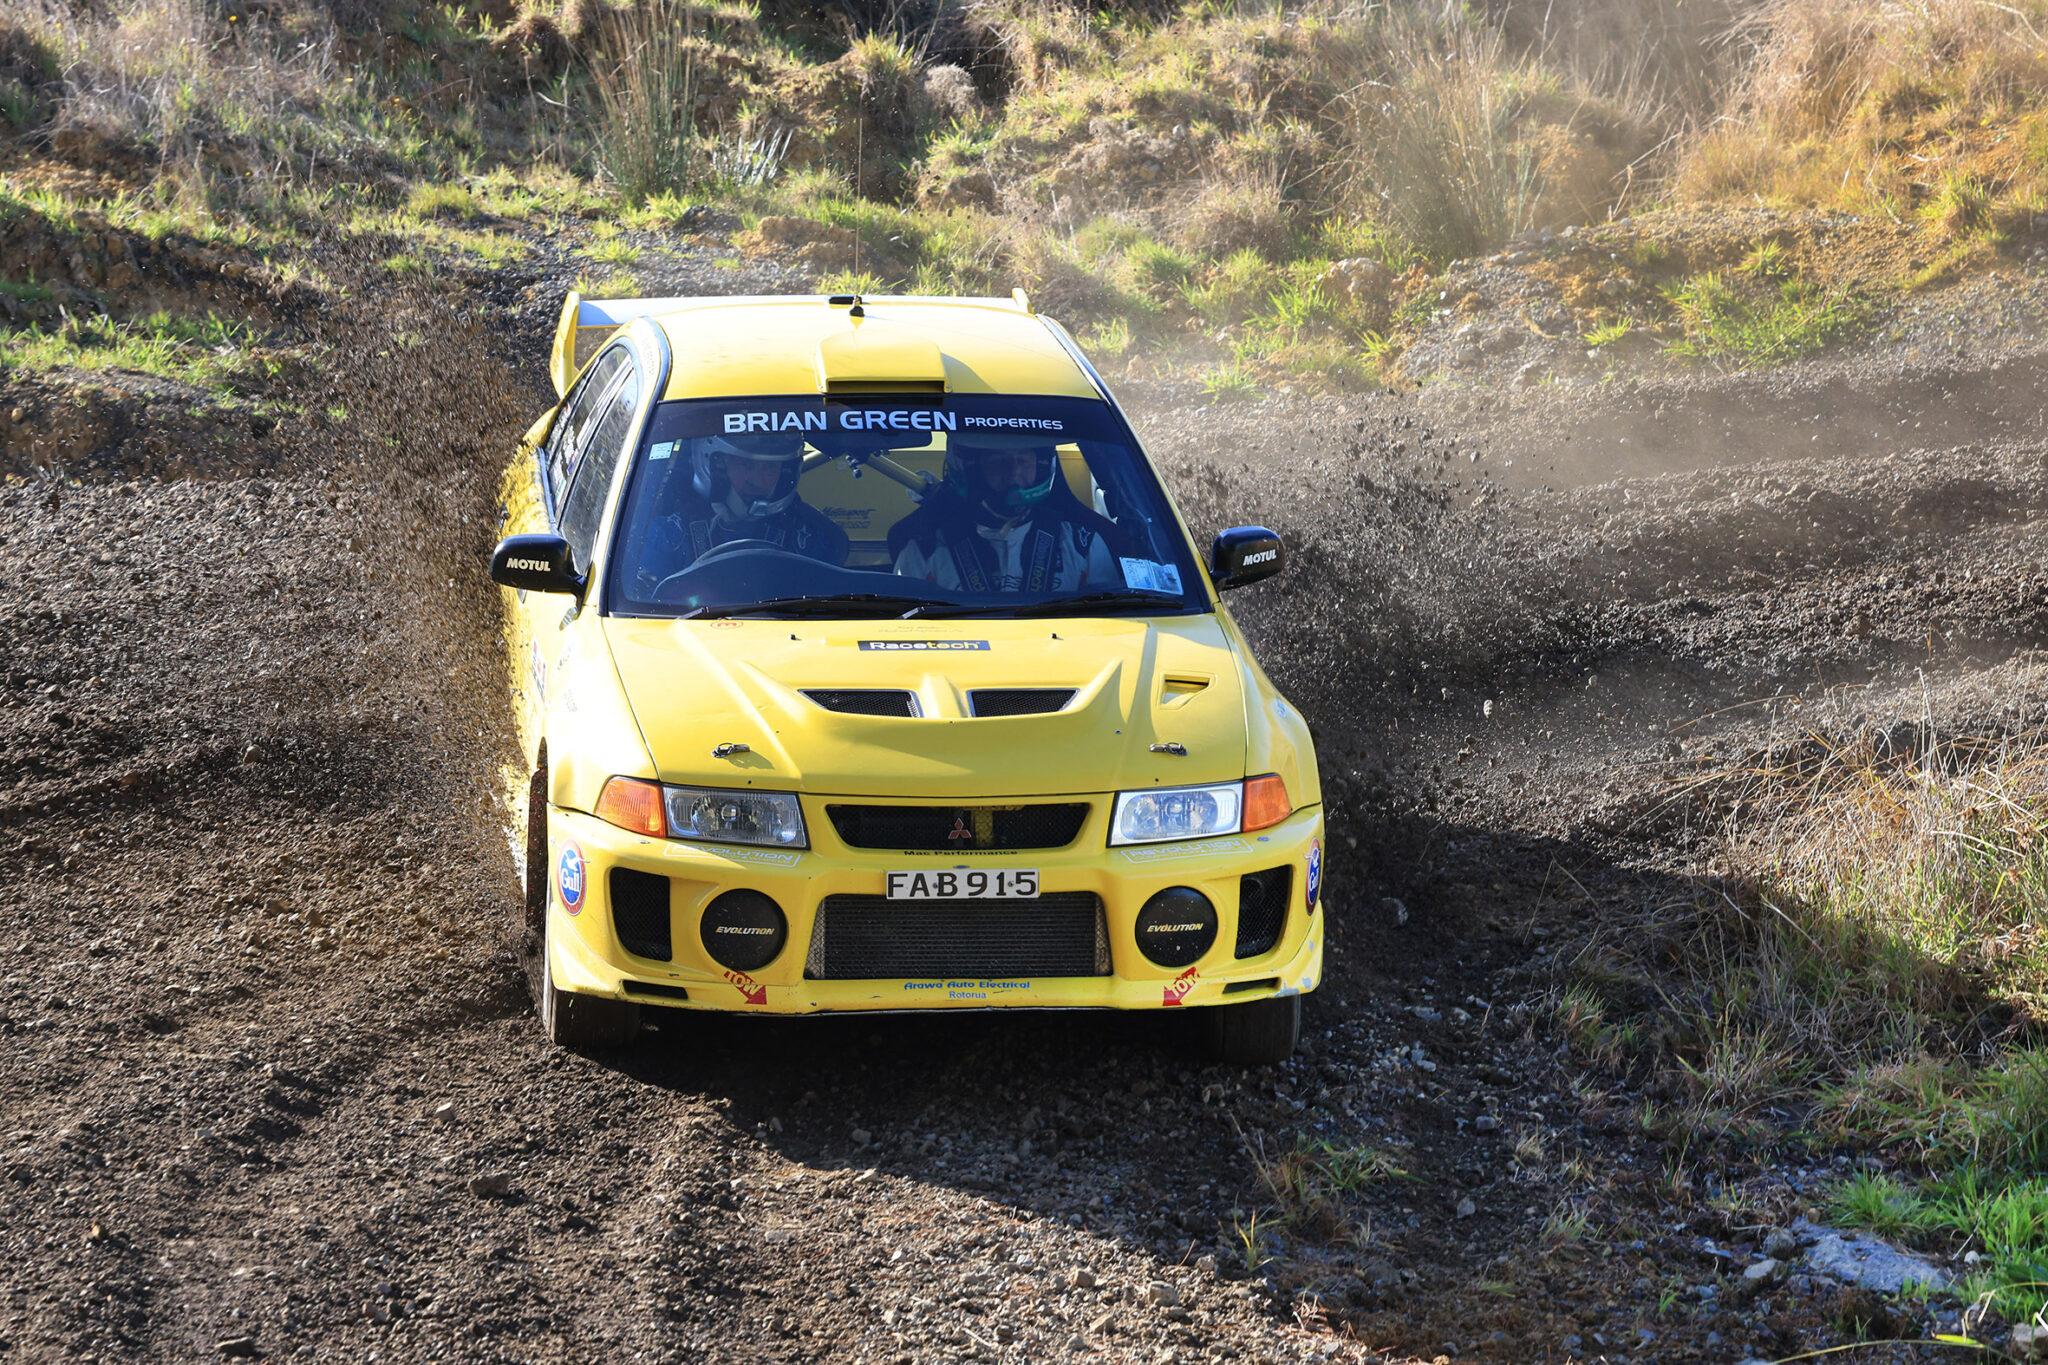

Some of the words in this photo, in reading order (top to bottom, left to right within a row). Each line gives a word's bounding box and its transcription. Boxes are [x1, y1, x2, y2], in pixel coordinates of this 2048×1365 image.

[723, 411, 827, 433] BRIAN
[839, 410, 957, 431] GREEN
[964, 416, 1064, 430] PROPERTIES
[506, 557, 551, 572] MOTUL
[1242, 549, 1277, 567] MOTUL
[869, 641, 979, 650] Racetech
[887, 871, 1037, 898] FAB915
[715, 926, 775, 936] EVOLUTION
[1146, 922, 1204, 933] EVOLUTION
[726, 969, 764, 996] TOW
[903, 981, 943, 990] Arawa
[978, 980, 1030, 989] Electrical
[1170, 972, 1201, 998] TOW
[949, 990, 987, 999] Rotorua
